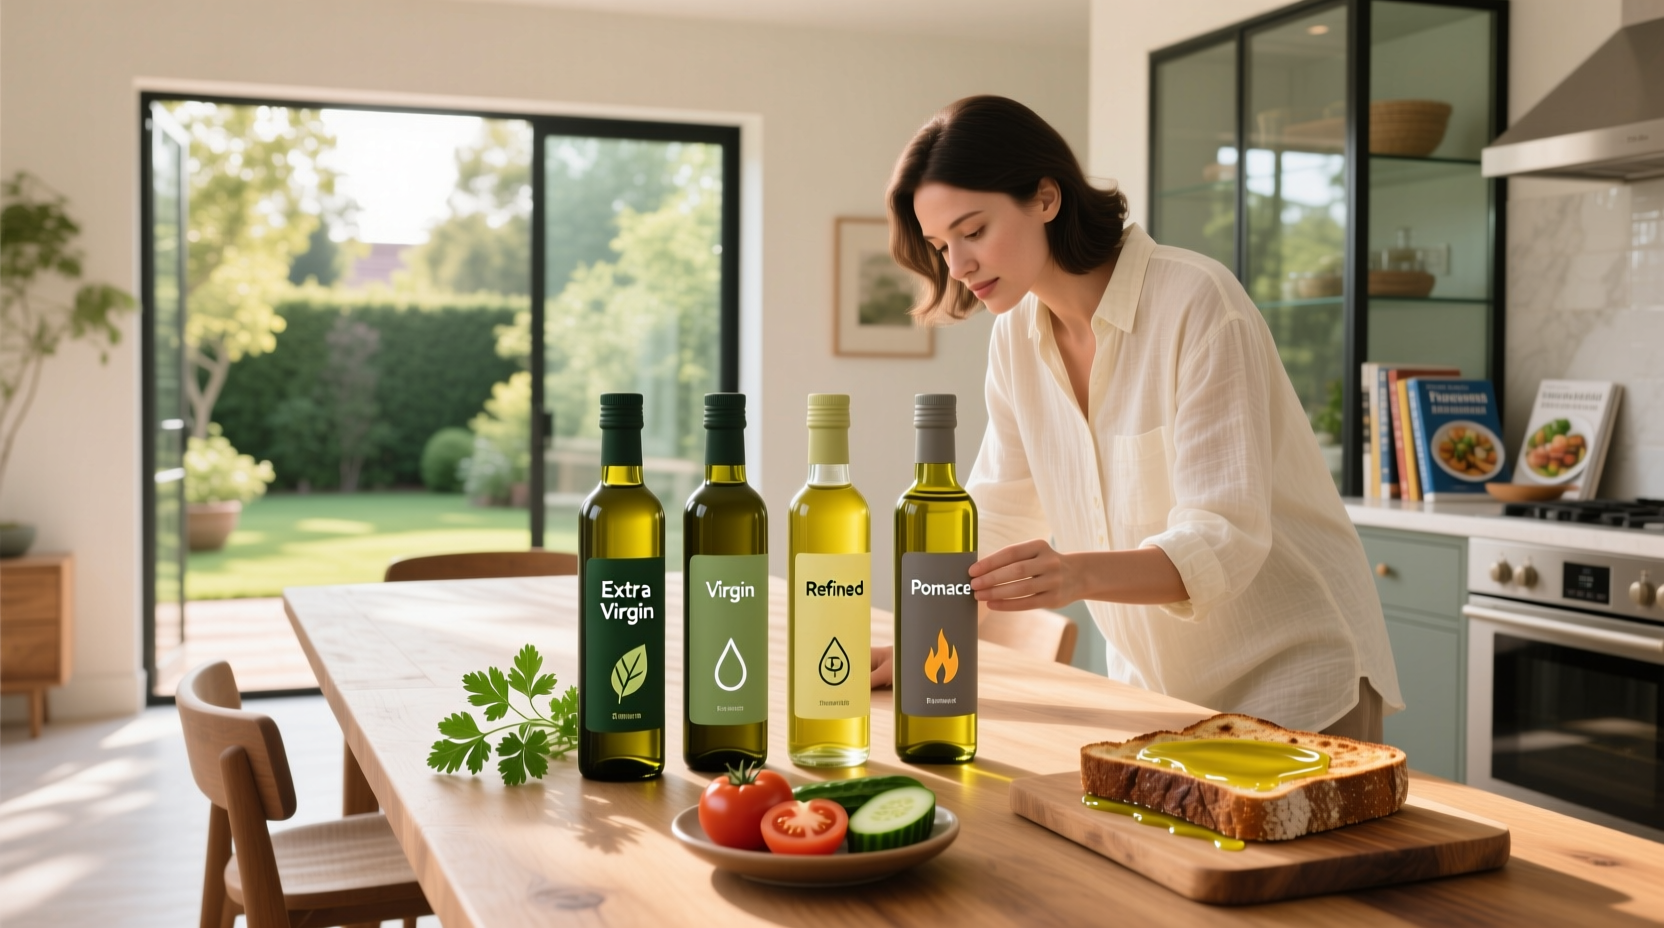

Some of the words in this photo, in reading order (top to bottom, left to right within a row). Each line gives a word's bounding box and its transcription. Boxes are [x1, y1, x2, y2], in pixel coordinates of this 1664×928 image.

[601, 580, 651, 599] Extra
[706, 580, 755, 603] Virgin
[806, 579, 864, 597] Refined
[911, 579, 971, 596] Pomace
[600, 602, 654, 626] Virgin
